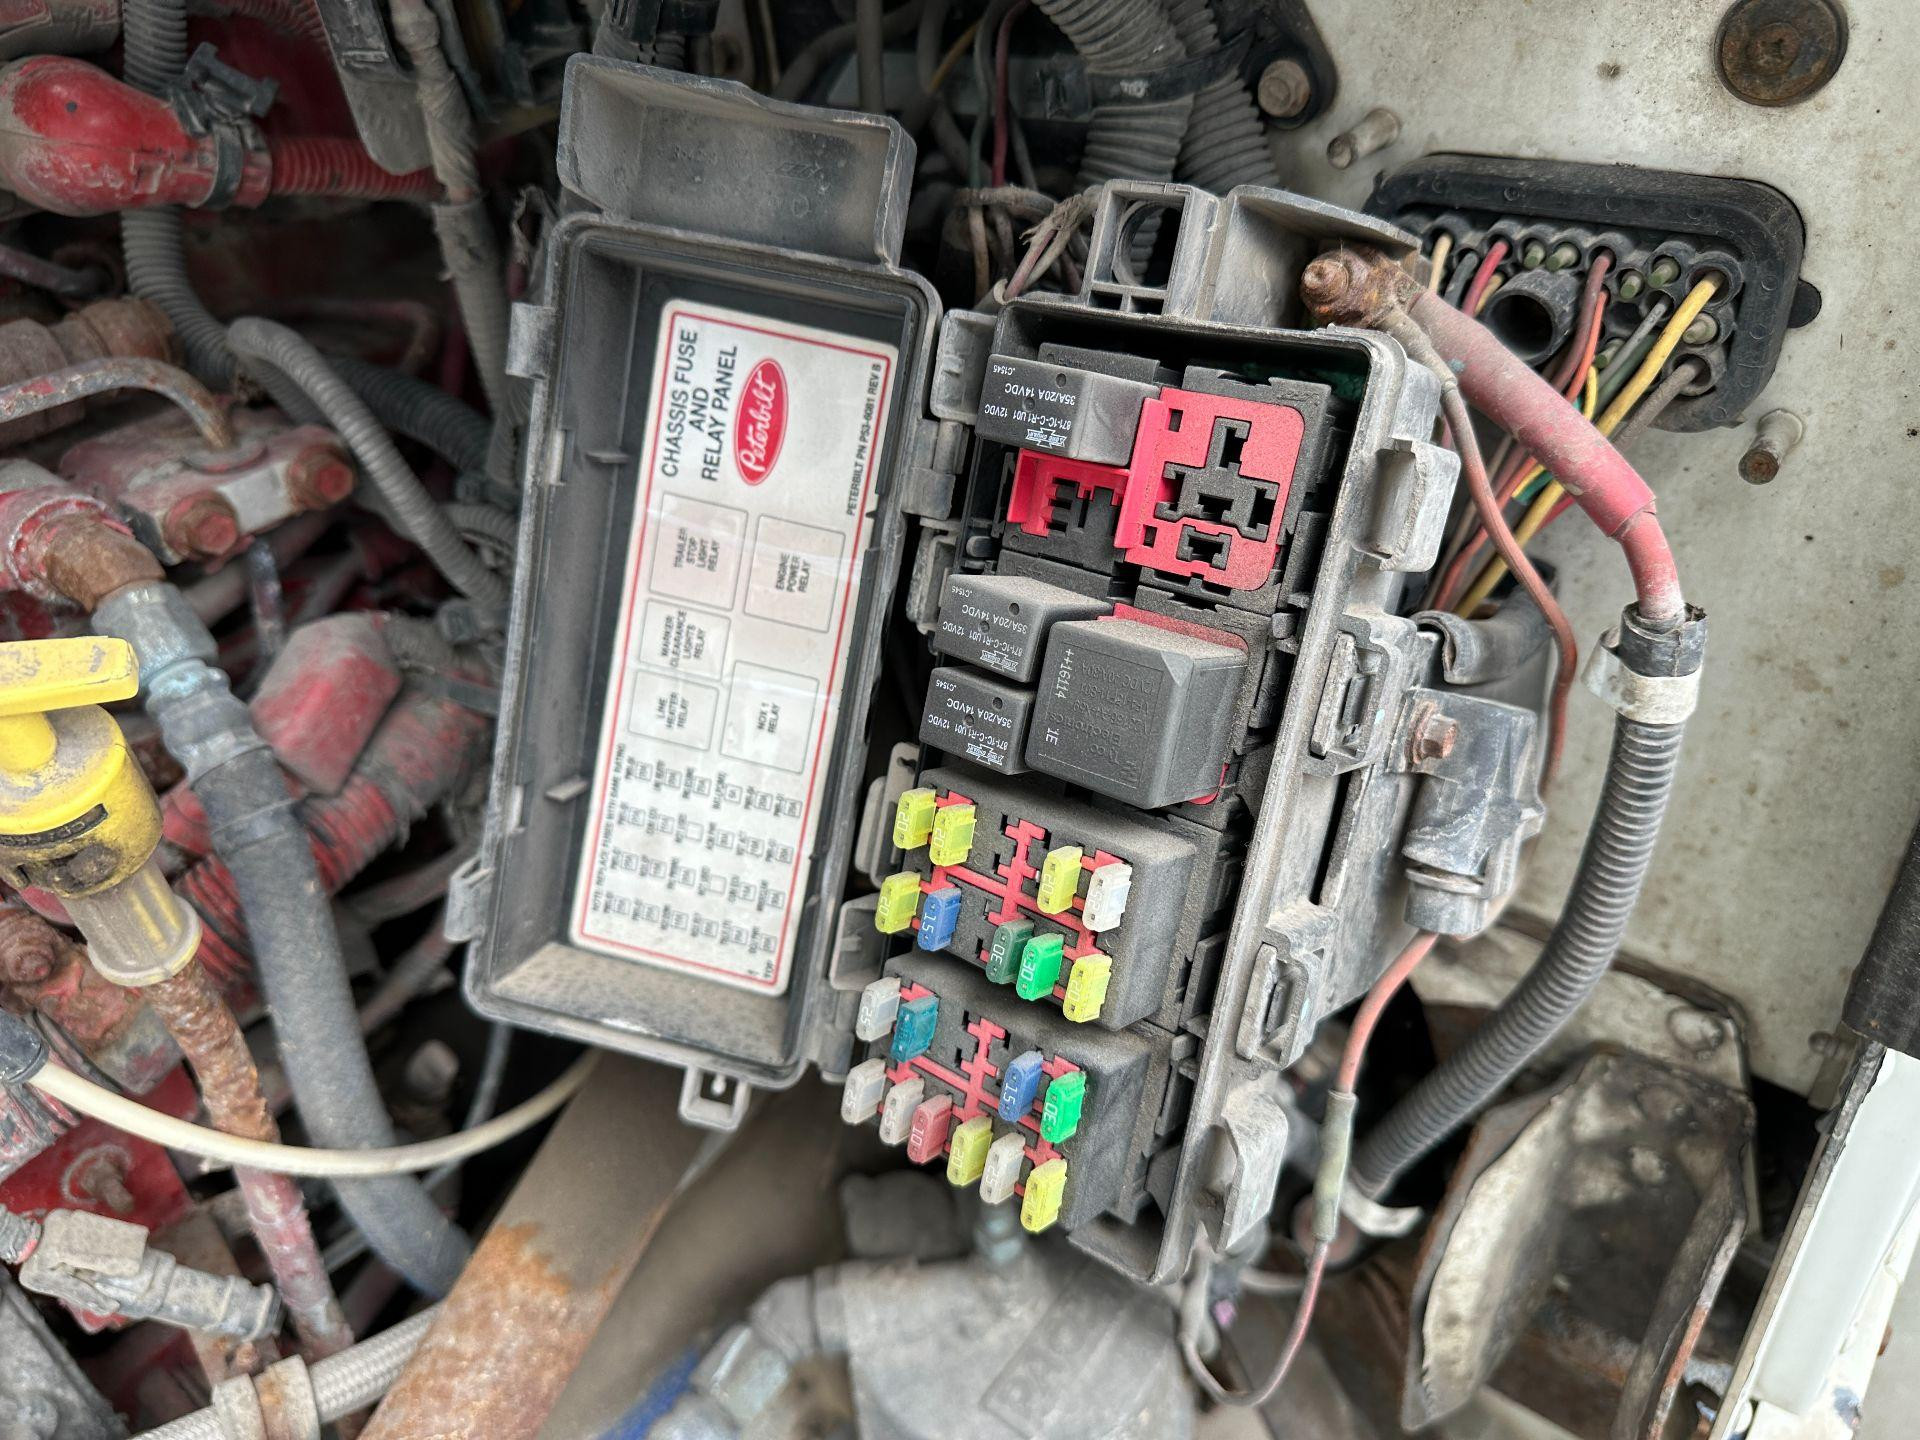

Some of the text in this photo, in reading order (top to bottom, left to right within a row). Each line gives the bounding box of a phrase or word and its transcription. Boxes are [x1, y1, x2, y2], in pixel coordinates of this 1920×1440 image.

[660, 329, 698, 477] CHASSIS FUSE
[1004, 383, 1076, 406] 35A/20A 14VDC
[687, 386, 710, 431] AND
[701, 343, 737, 481] RELAY PANEL
[985, 404, 1008, 417] 12VDC
[740, 369, 777, 472] Peterbilt
[846, 462, 864, 515] PETERBILT
[855, 444, 867, 460] PN
[867, 372, 880, 394] REV
[674, 526, 687, 567] TRAILER
[685, 536, 698, 565] STOP
[696, 538, 709, 568] LIGHT
[707, 539, 720, 572] RELAY
[775, 552, 790, 590] ENGINE
[786, 555, 801, 592] POWER
[798, 559, 811, 592] RELAY
[943, 621, 965, 635] 12VDC
[962, 605, 1028, 634] 35A/20A 14VDC
[670, 609, 686, 667] CLEARANCE
[682, 623, 695, 659] LIGHTS
[693, 627, 706, 659] RELAY
[1055, 648, 1074, 699] ++16114
[656, 697, 666, 719] LINE
[666, 692, 679, 729] HEATER
[677, 697, 689, 728] RELAY
[767, 702, 780, 733] RELAY
[946, 699, 1012, 728] 35A/20A 14VDC
[928, 715, 950, 729] 12VDC
[897, 812, 909, 832] 20
[932, 828, 945, 847] 20
[1042, 873, 1056, 894] 20
[879, 896, 891, 916] 20
[1087, 890, 1103, 910] 25
[922, 914, 937, 934] 15
[991, 944, 1006, 965] 30
[1021, 961, 1036, 981] 30
[1067, 980, 1083, 1002] 20
[861, 1007, 873, 1028] 25
[845, 1090, 857, 1110] 25
[1003, 1083, 1018, 1105] 15
[884, 1109, 897, 1129] 25
[1043, 1103, 1058, 1126] 30
[911, 1127, 925, 1146] 10
[951, 1148, 965, 1168] 20
[986, 1165, 1000, 1186] 25
